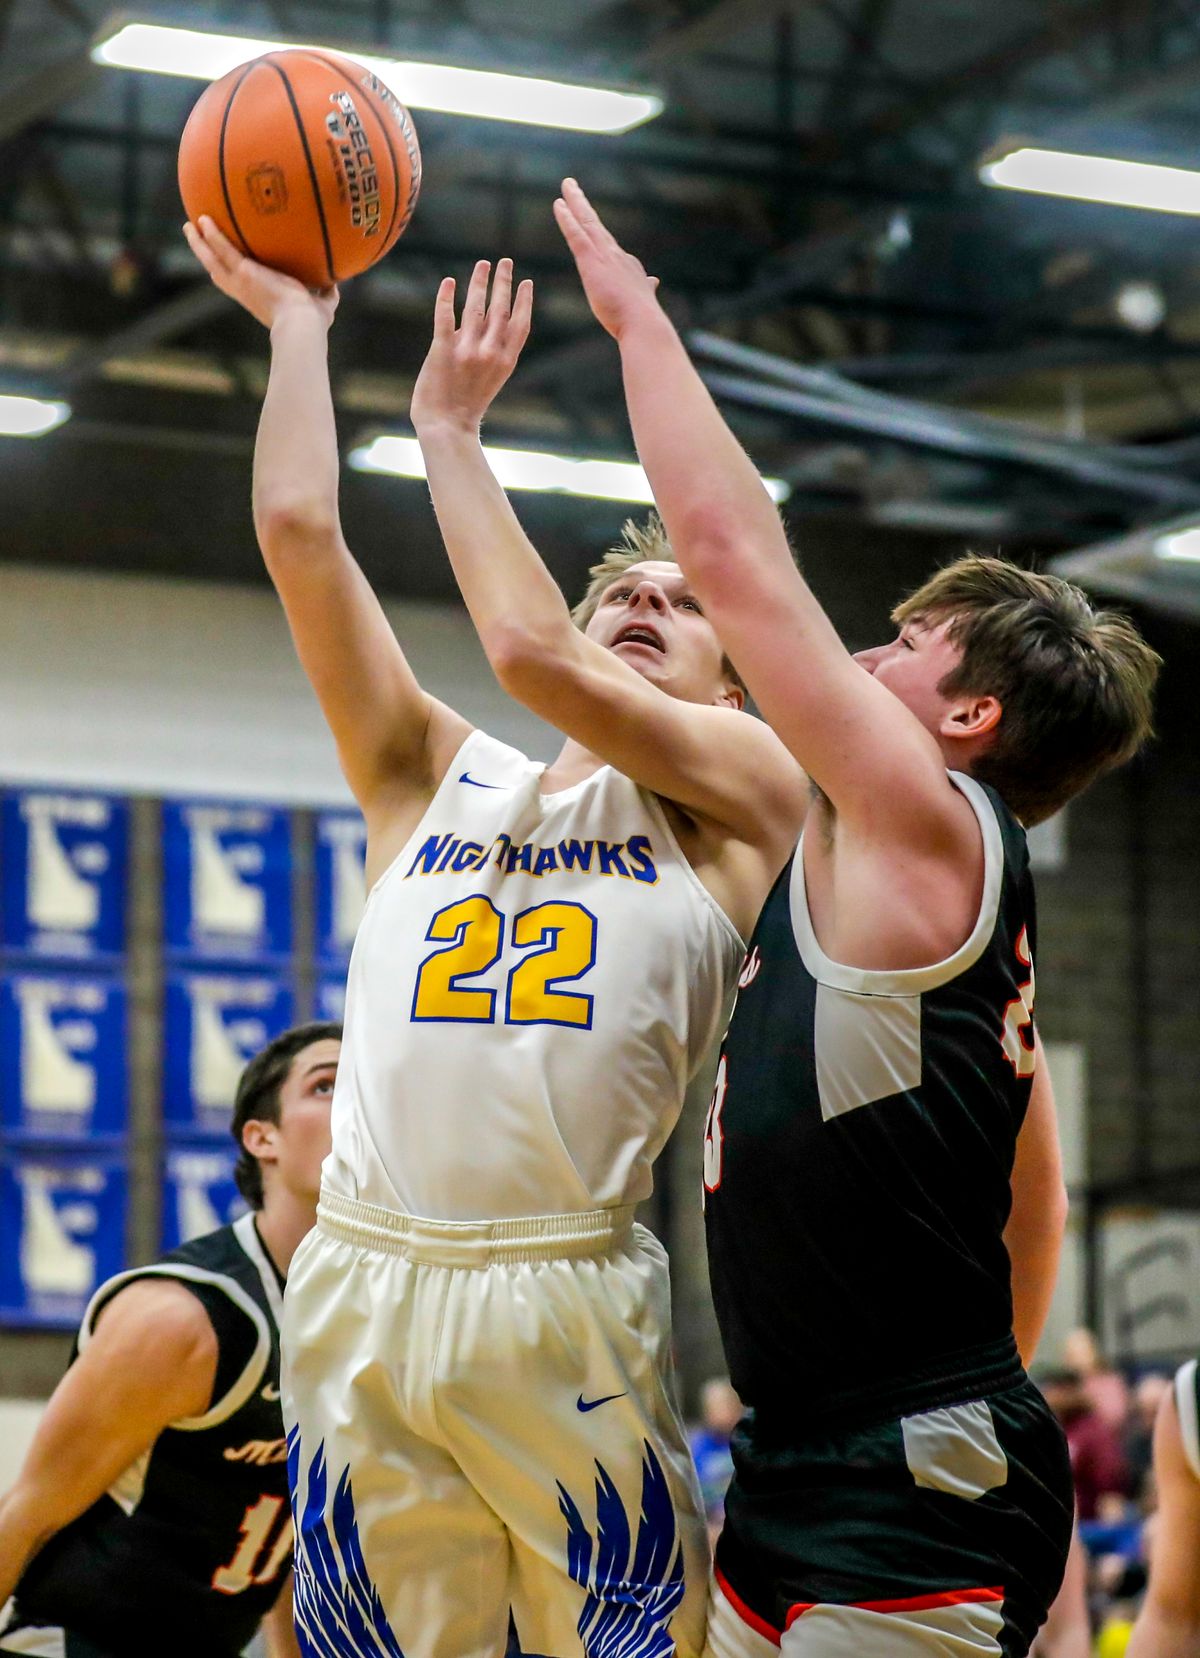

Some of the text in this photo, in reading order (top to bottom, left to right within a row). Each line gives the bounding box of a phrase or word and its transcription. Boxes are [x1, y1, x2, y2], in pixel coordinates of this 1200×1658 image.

[329, 90, 381, 237] PRECISION
[402, 832, 661, 887] NIGHAWKS
[410, 893, 599, 1030] 22
